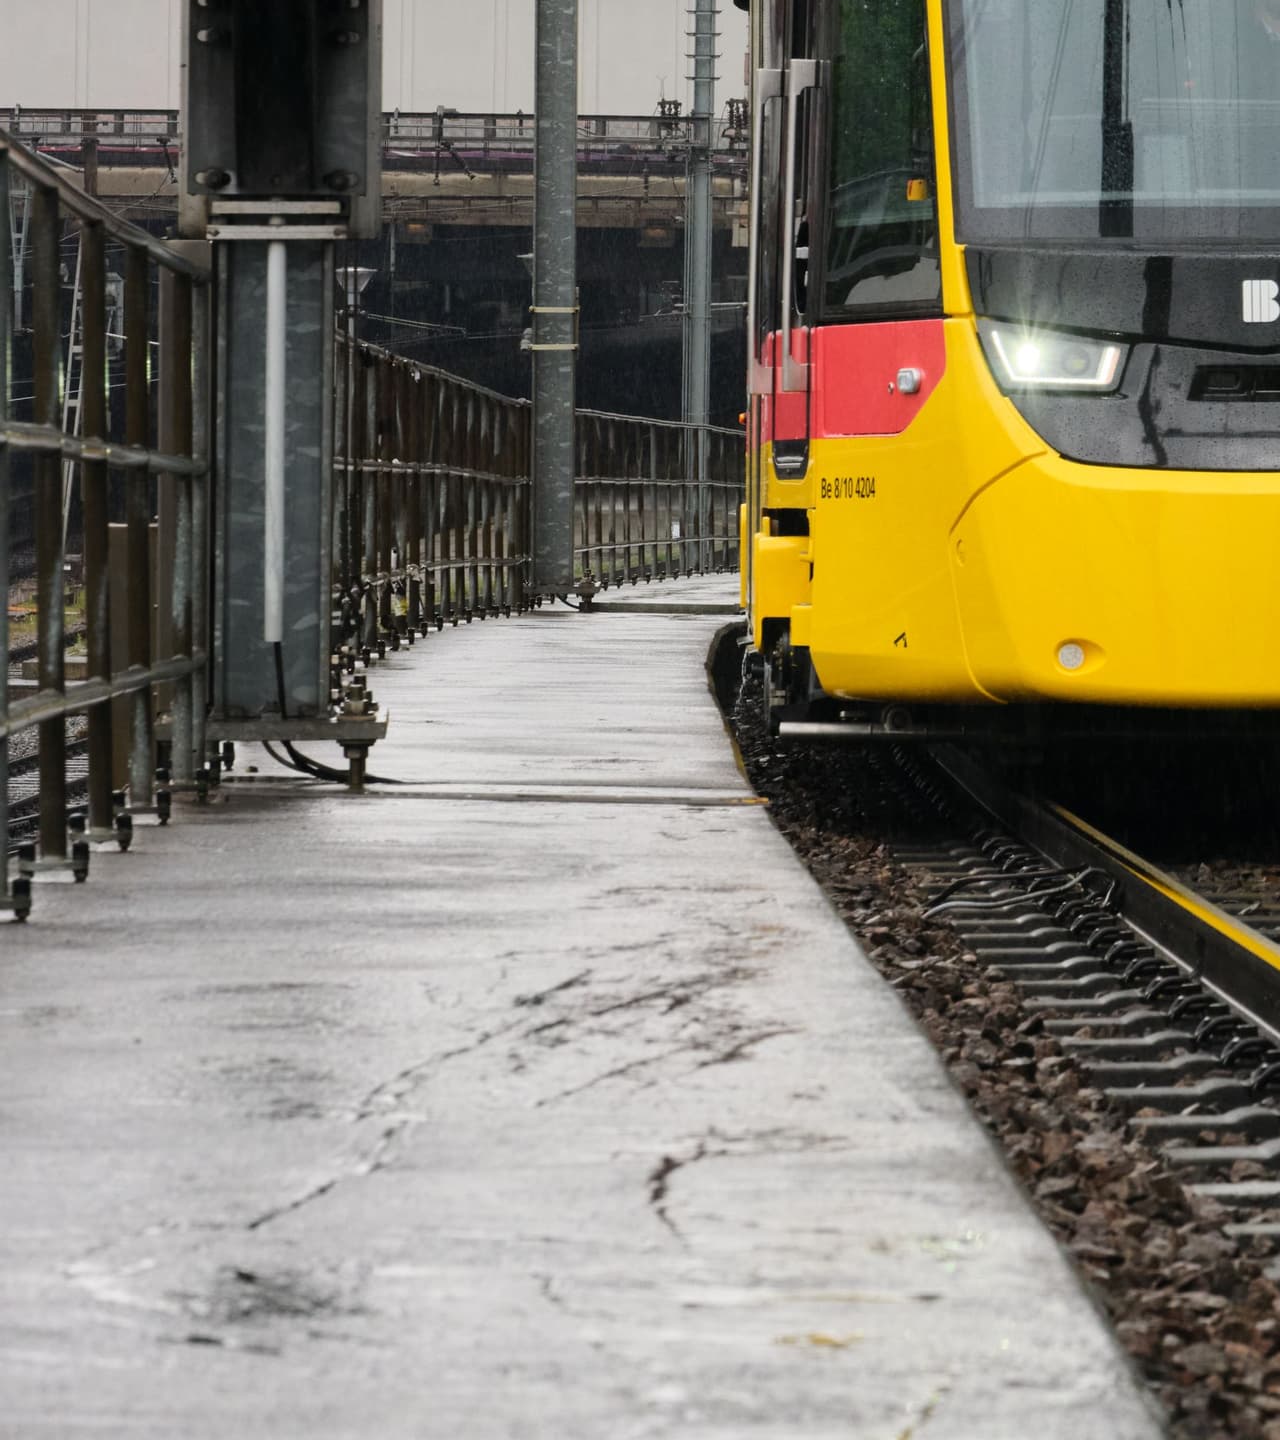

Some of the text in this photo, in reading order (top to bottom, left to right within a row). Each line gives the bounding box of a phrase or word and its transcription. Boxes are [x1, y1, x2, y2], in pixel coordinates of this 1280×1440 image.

[821, 477, 876, 498] Be 8/10 4204
